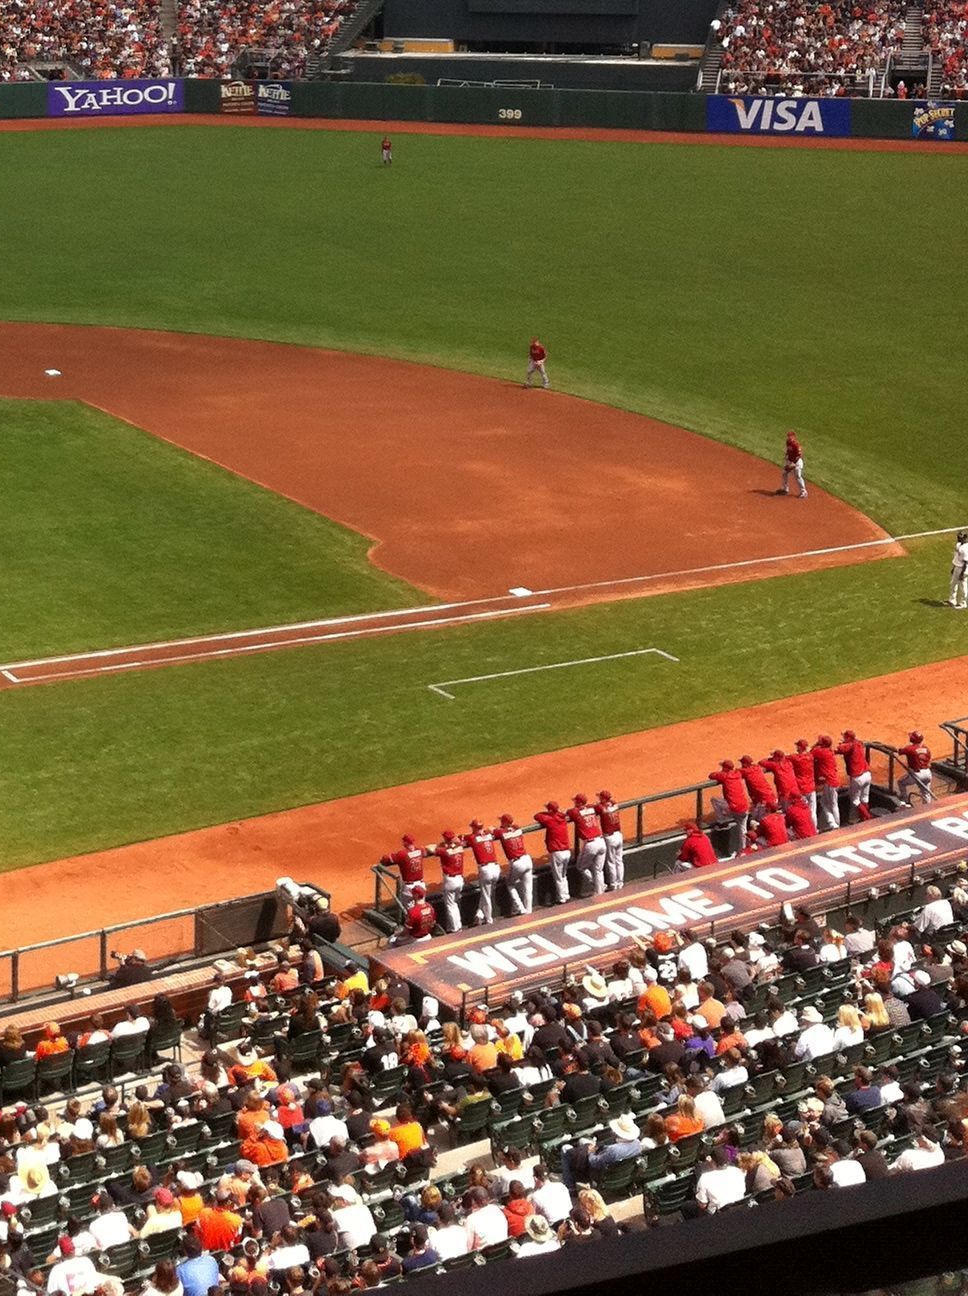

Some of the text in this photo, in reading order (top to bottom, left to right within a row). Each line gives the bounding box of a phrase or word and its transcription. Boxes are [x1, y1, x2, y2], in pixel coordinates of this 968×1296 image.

[55, 82, 175, 111] YAHOO!
[498, 109, 522, 119] 399
[728, 99, 824, 132] VISA
[447, 890, 734, 979] WELCOME
[722, 867, 809, 900] TO
[810, 829, 937, 879] AT&T
